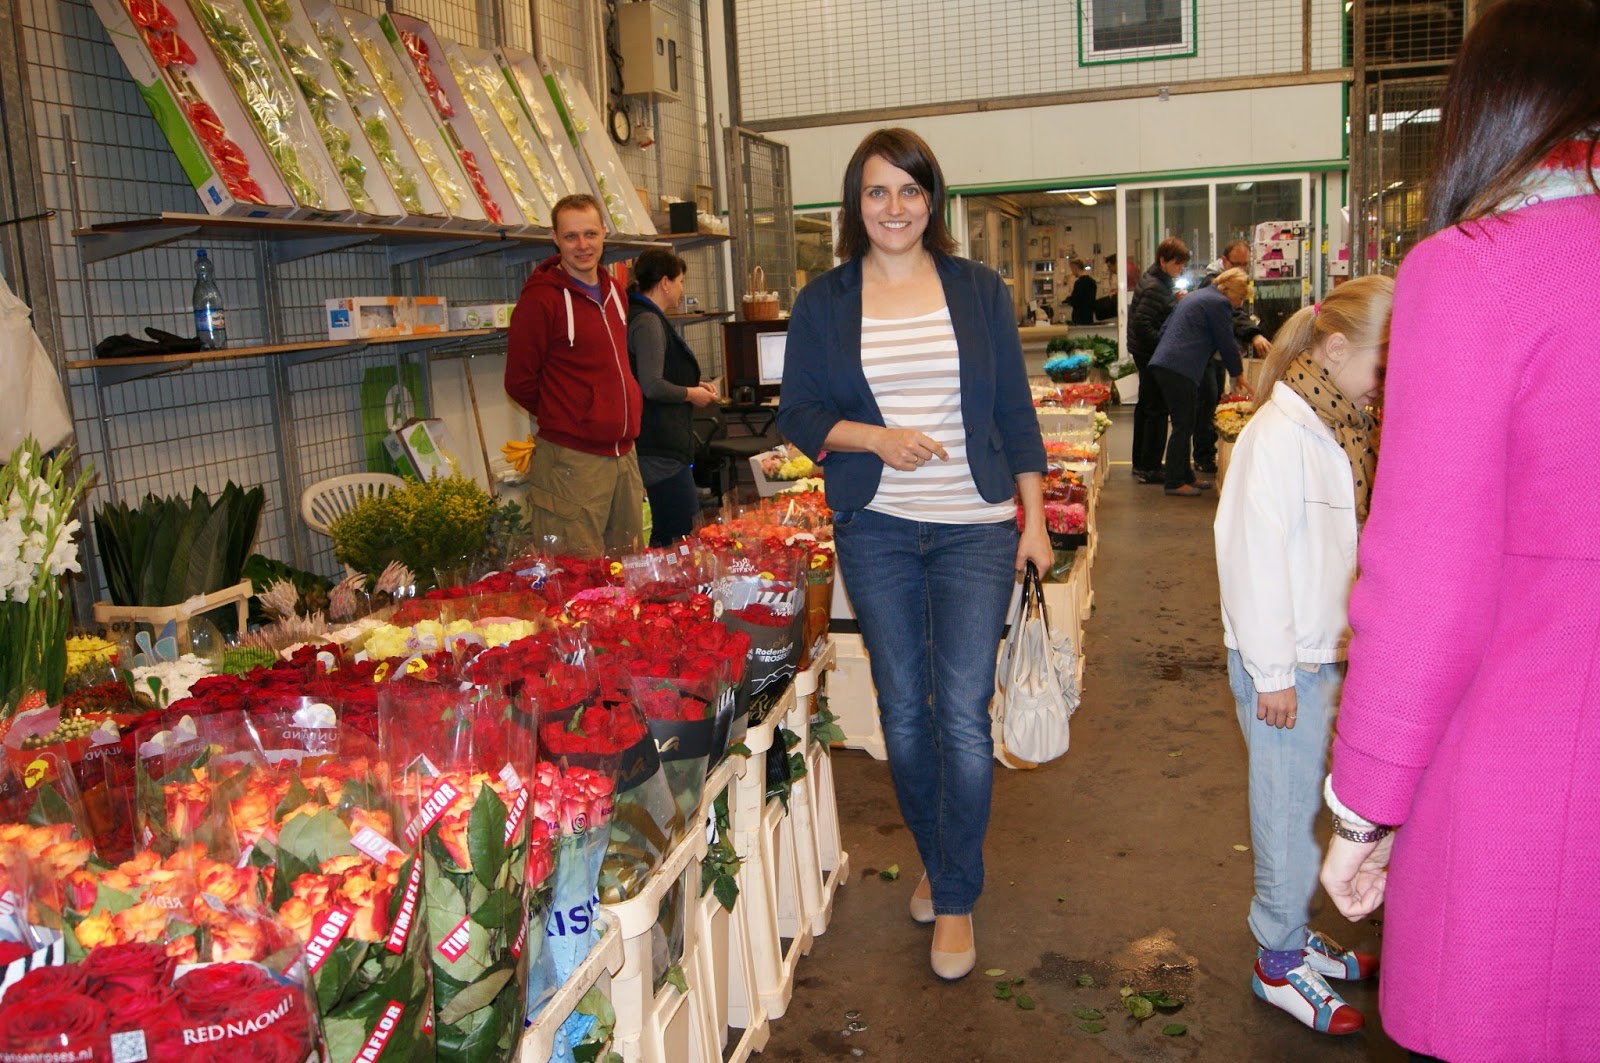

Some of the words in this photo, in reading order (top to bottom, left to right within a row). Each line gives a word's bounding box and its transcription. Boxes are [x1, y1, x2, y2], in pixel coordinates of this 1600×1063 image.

[389, 858, 422, 947] TIMAFLOR
[182, 1024, 225, 1046] RED
[226, 993, 294, 1039] NAOMI!
